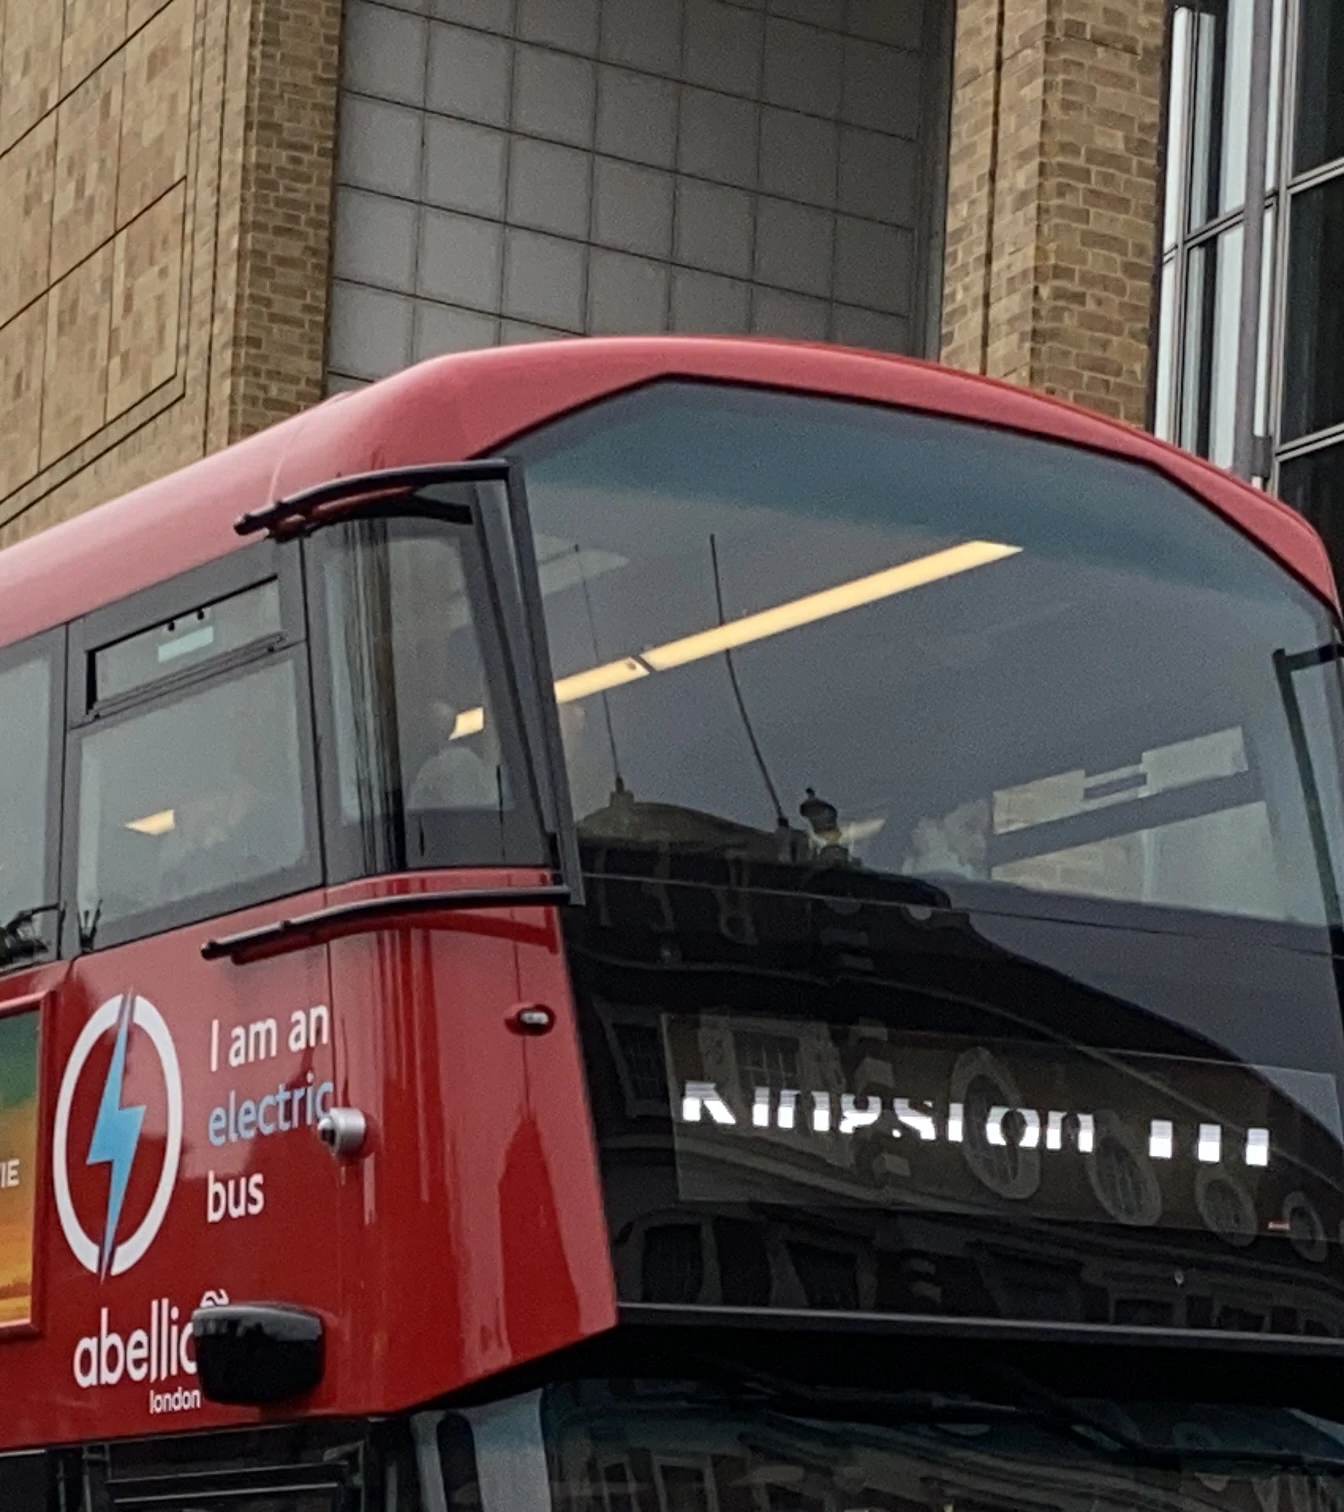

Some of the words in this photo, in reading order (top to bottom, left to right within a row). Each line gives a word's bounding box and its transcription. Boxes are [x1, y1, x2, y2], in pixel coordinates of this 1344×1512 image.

[209, 1020, 220, 1073] I
[228, 1017, 277, 1068] am
[288, 1004, 330, 1050] an
[208, 1073, 335, 1147] electric
[207, 1170, 265, 1224] bus
[149, 1388, 202, 1414] london
